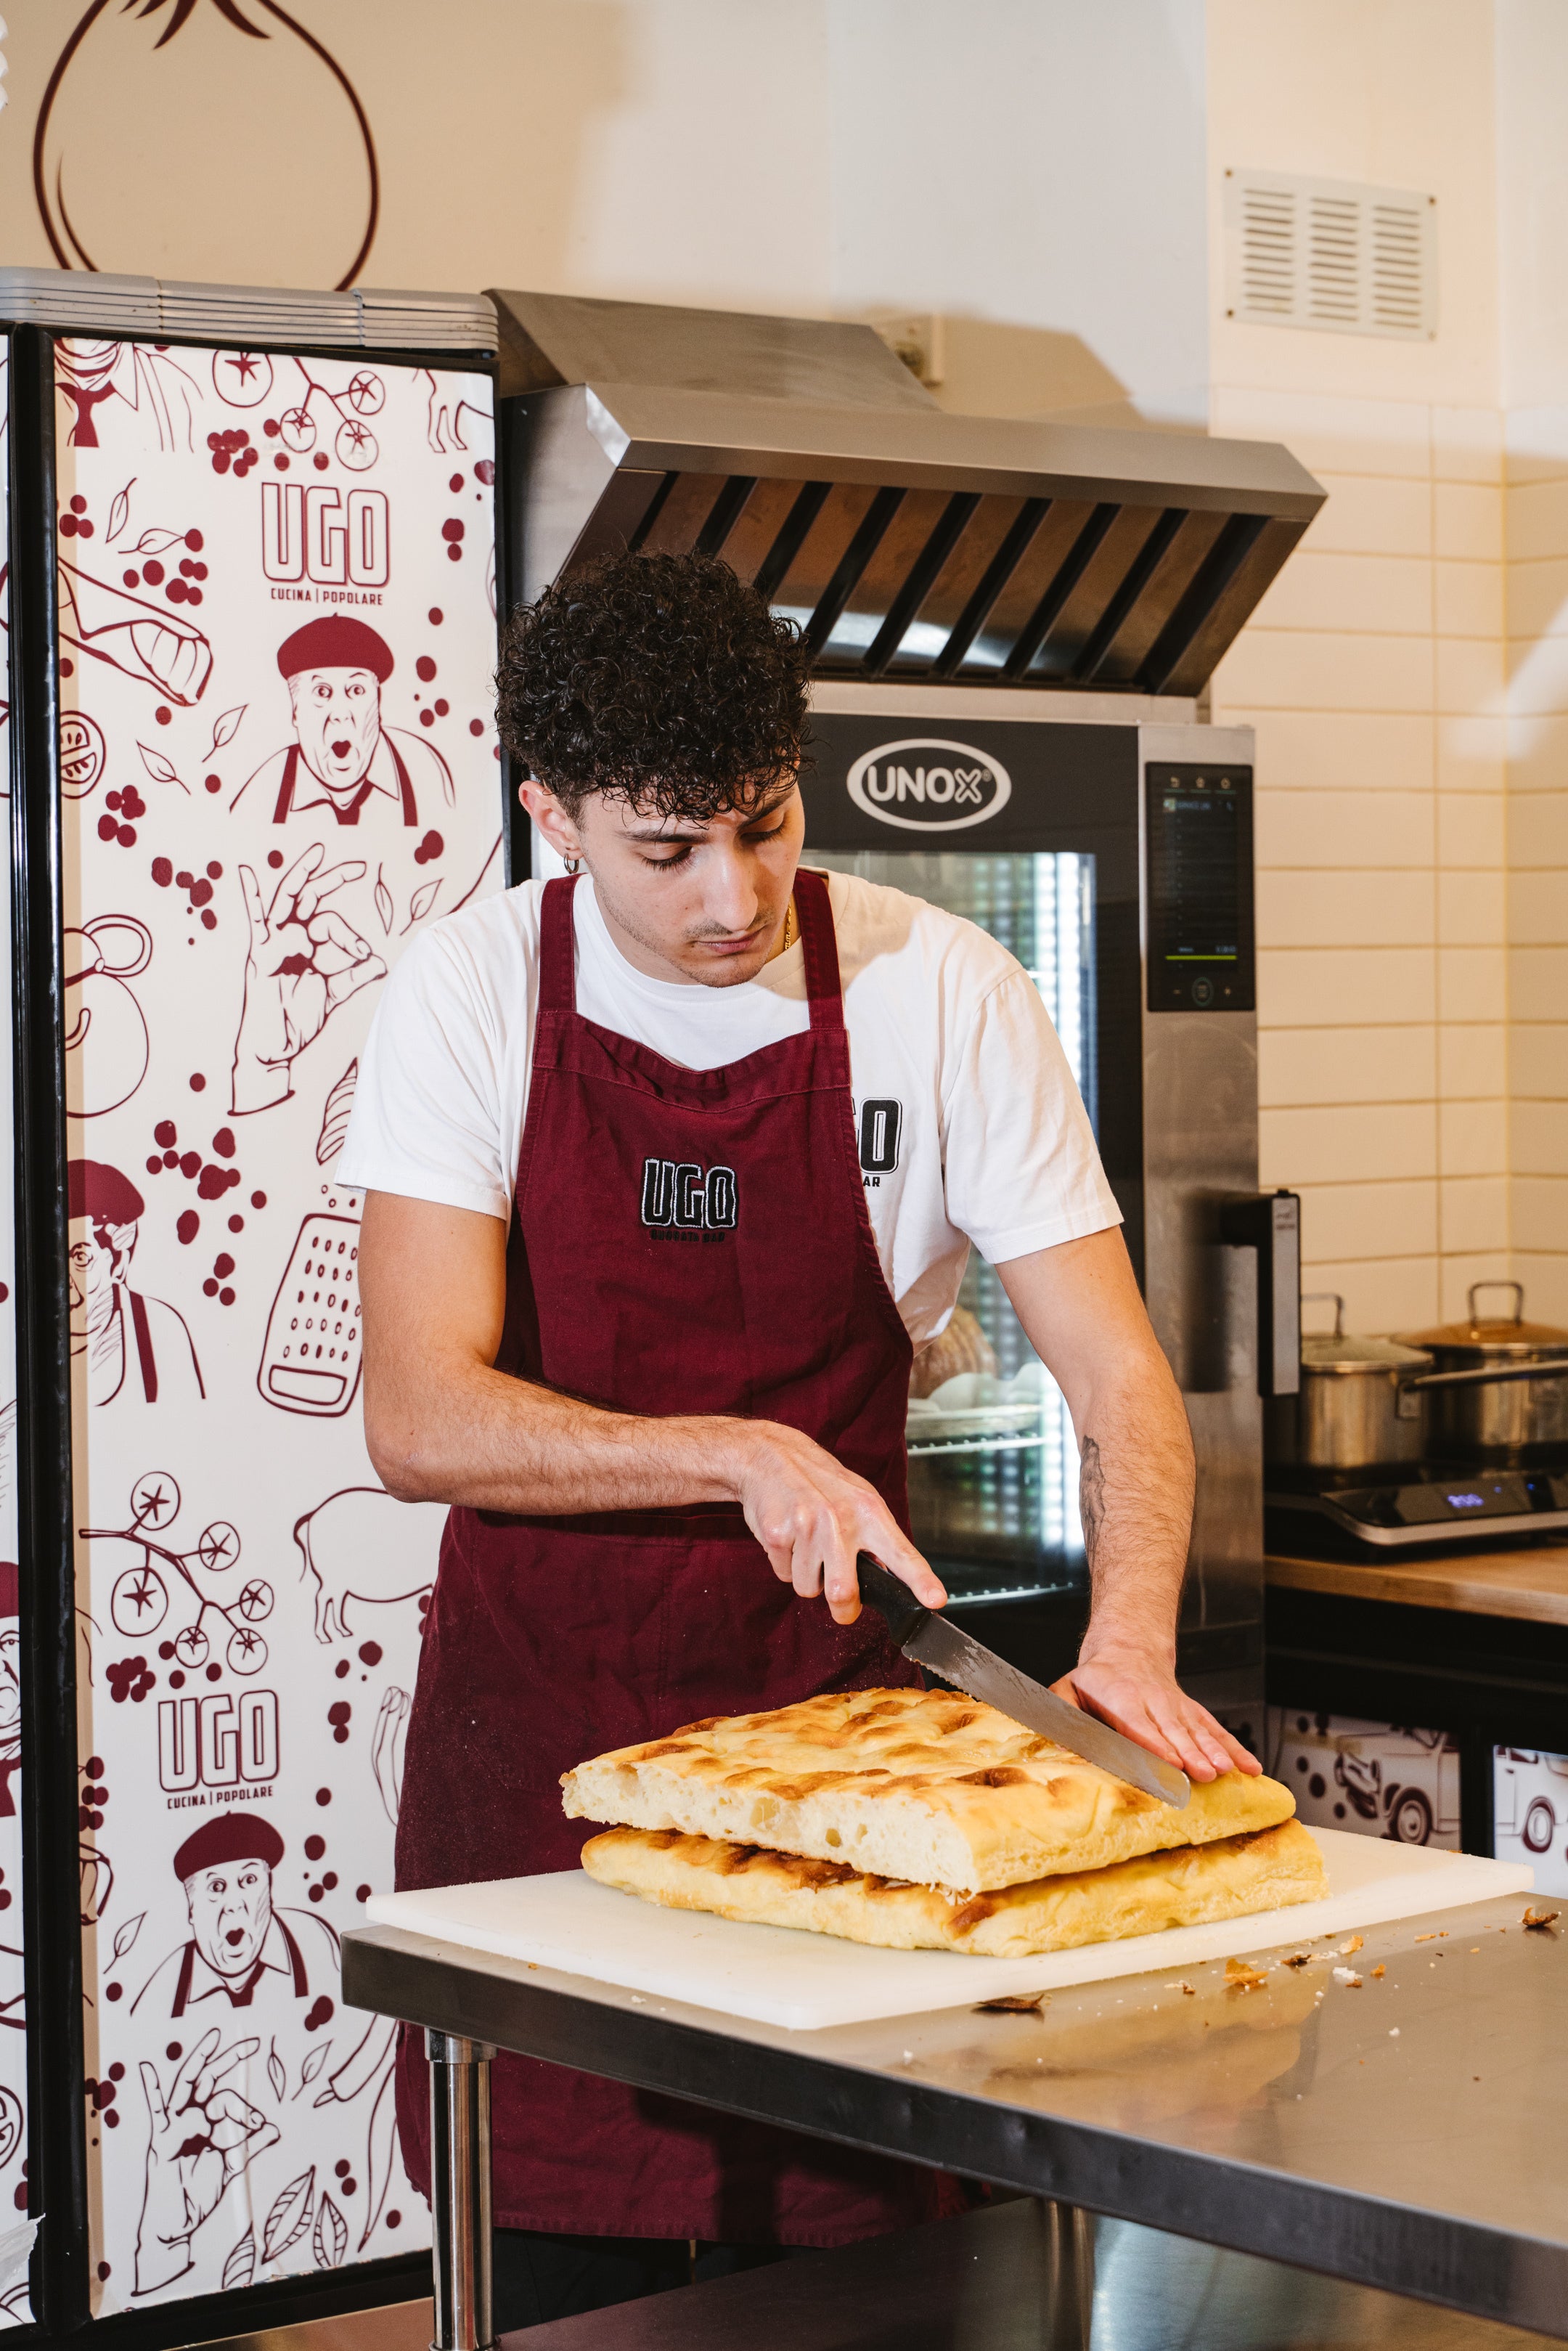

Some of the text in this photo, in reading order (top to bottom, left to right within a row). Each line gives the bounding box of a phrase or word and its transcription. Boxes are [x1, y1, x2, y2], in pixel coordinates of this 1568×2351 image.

[261, 482, 390, 588] UGO
[271, 588, 383, 606] CUCINA POPOLARE
[867, 765, 982, 804] UNOX
[641, 1157, 738, 1229] UGO
[158, 1689, 280, 1793] UGO
[168, 1785, 273, 1809] CUCINA POPOLARE
